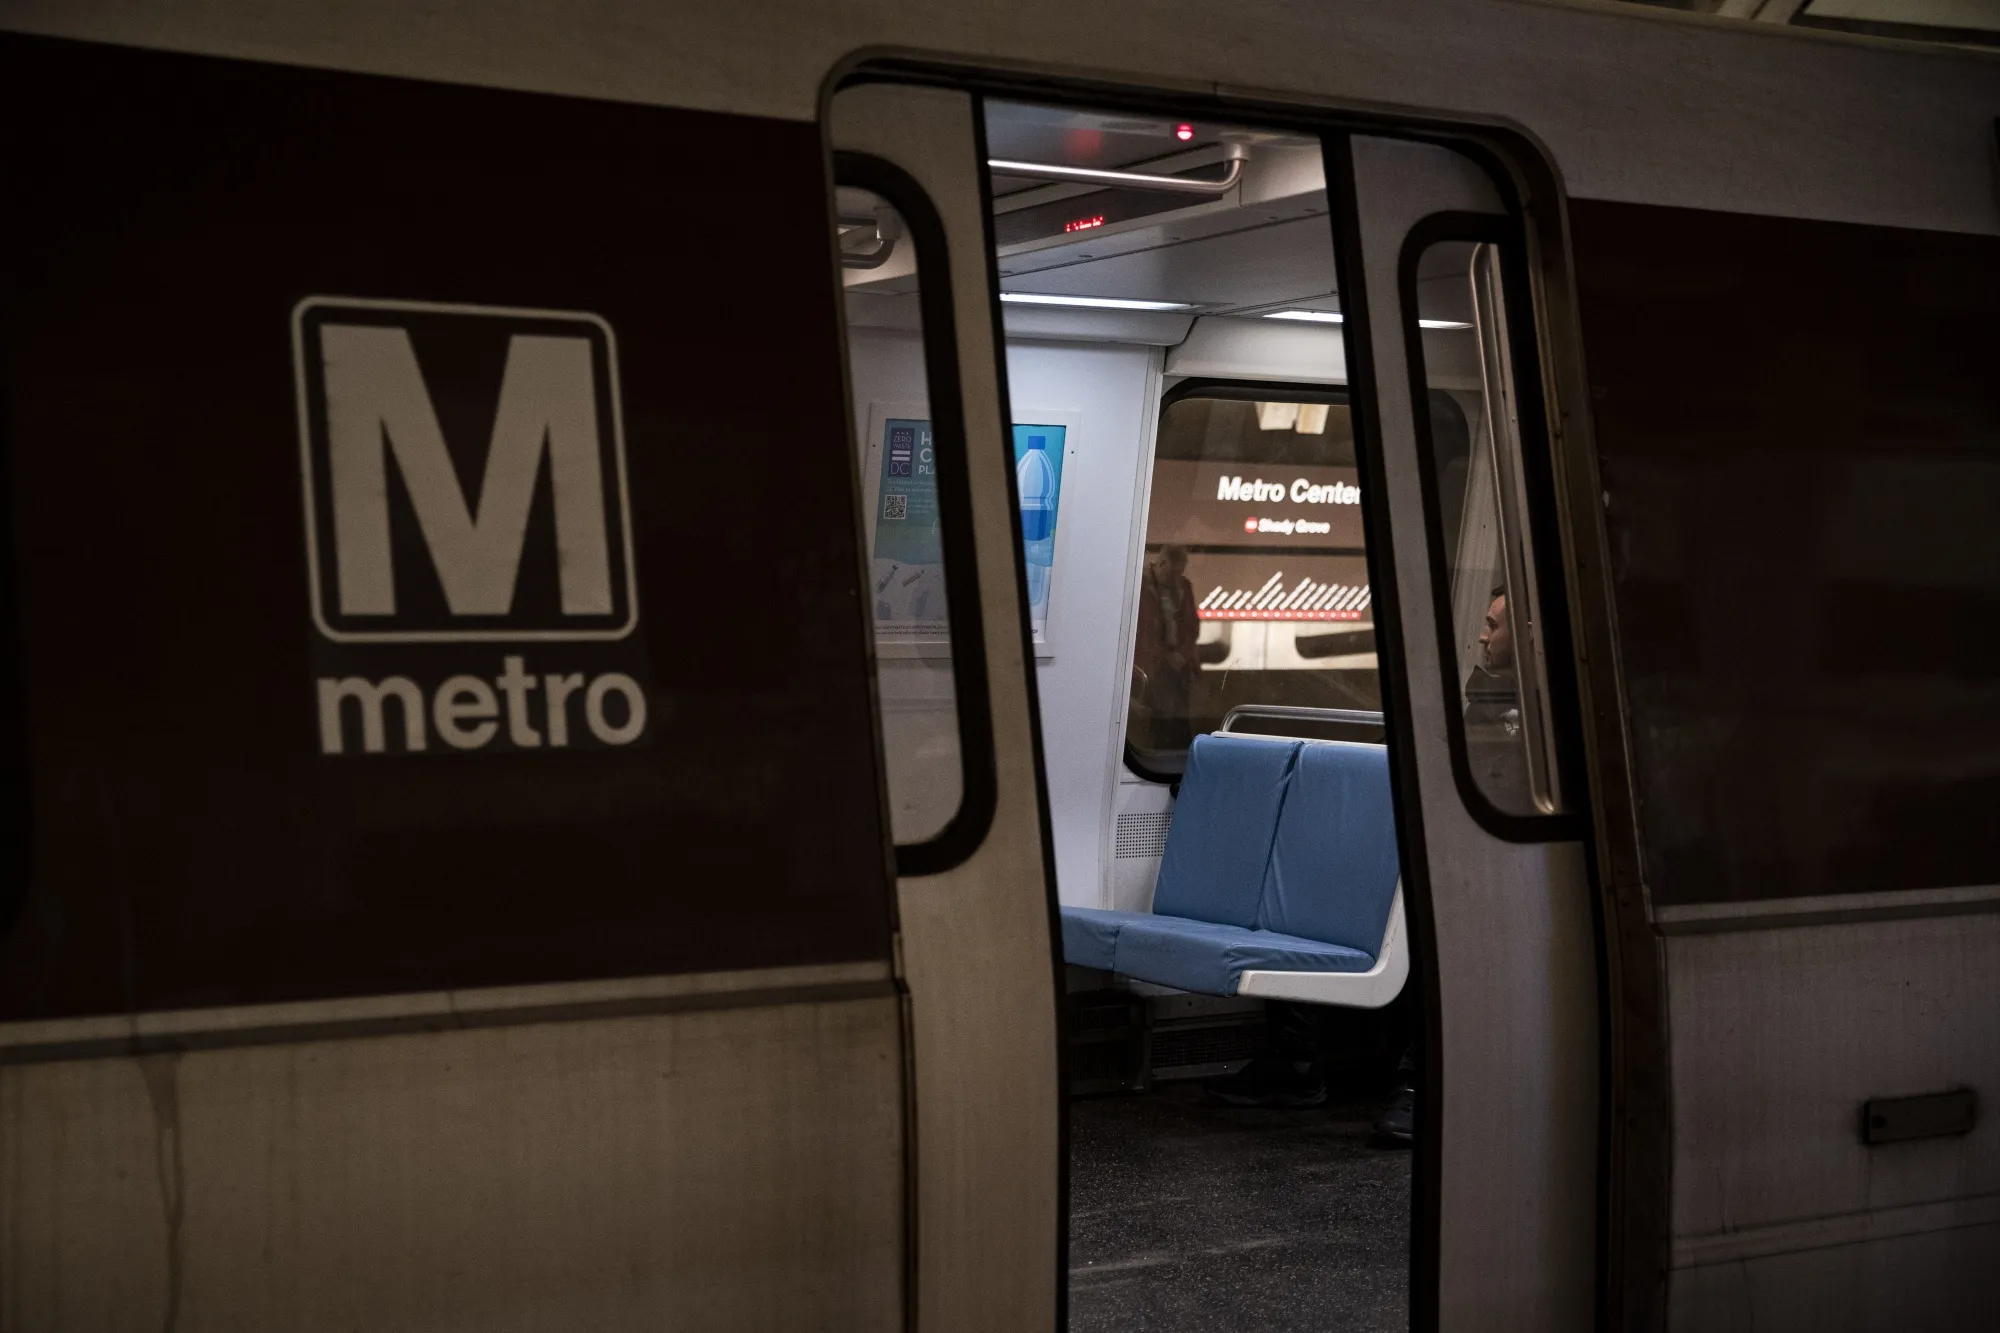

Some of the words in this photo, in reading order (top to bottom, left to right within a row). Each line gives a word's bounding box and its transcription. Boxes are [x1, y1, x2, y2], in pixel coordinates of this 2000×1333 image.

[892, 435, 912, 443] ZERO
[319, 323, 614, 616] M
[890, 462, 910, 475] DC
[1217, 475, 1286, 502] Metro
[316, 654, 647, 755] metro
